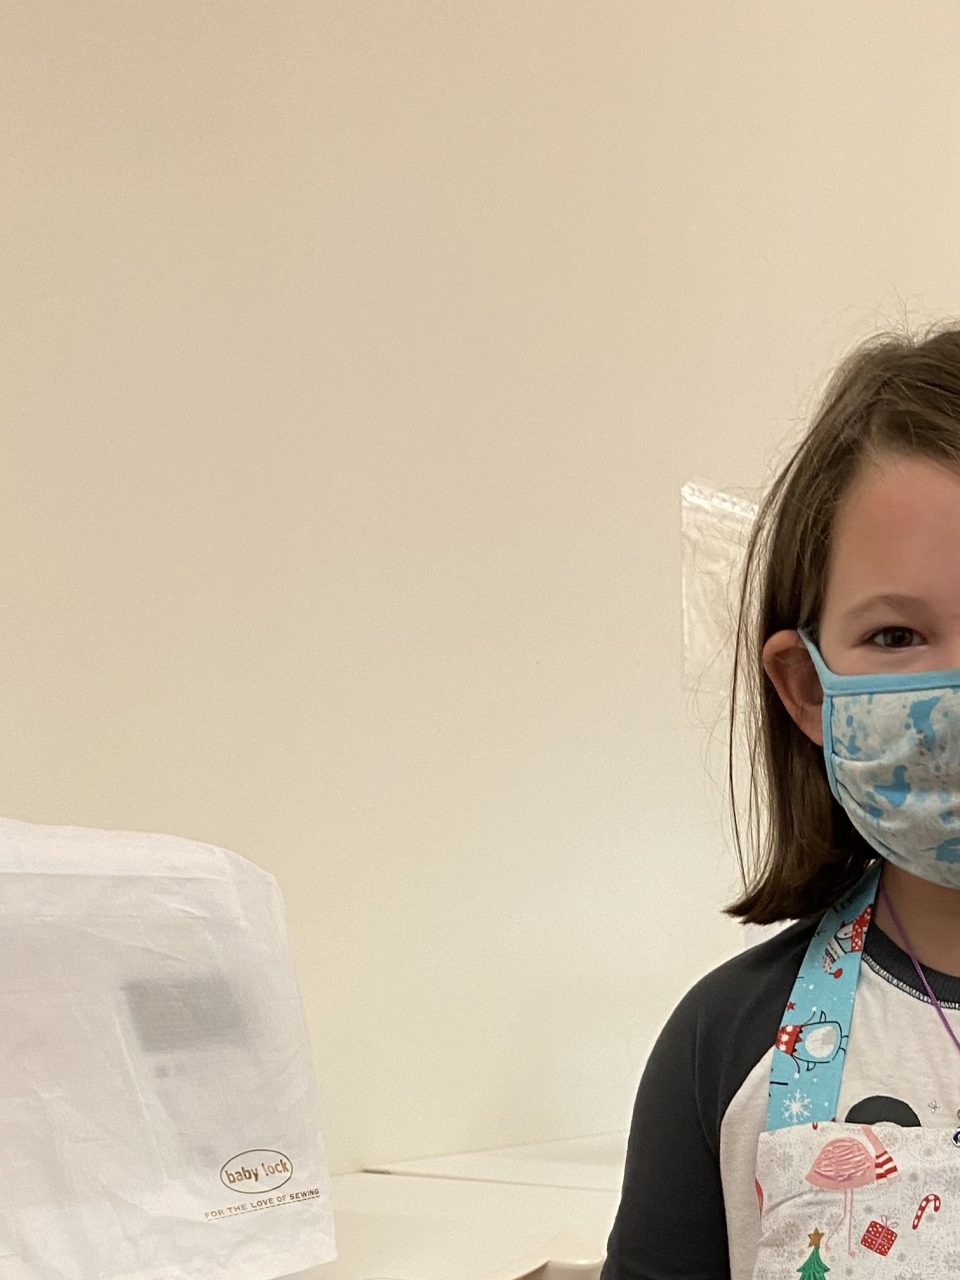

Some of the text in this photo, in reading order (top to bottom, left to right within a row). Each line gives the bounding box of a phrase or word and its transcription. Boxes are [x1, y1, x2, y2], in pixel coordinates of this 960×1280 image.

[225, 1159, 290, 1184] baby lock
[204, 1188, 320, 1218] FOR THE LOVE OF SEWING
